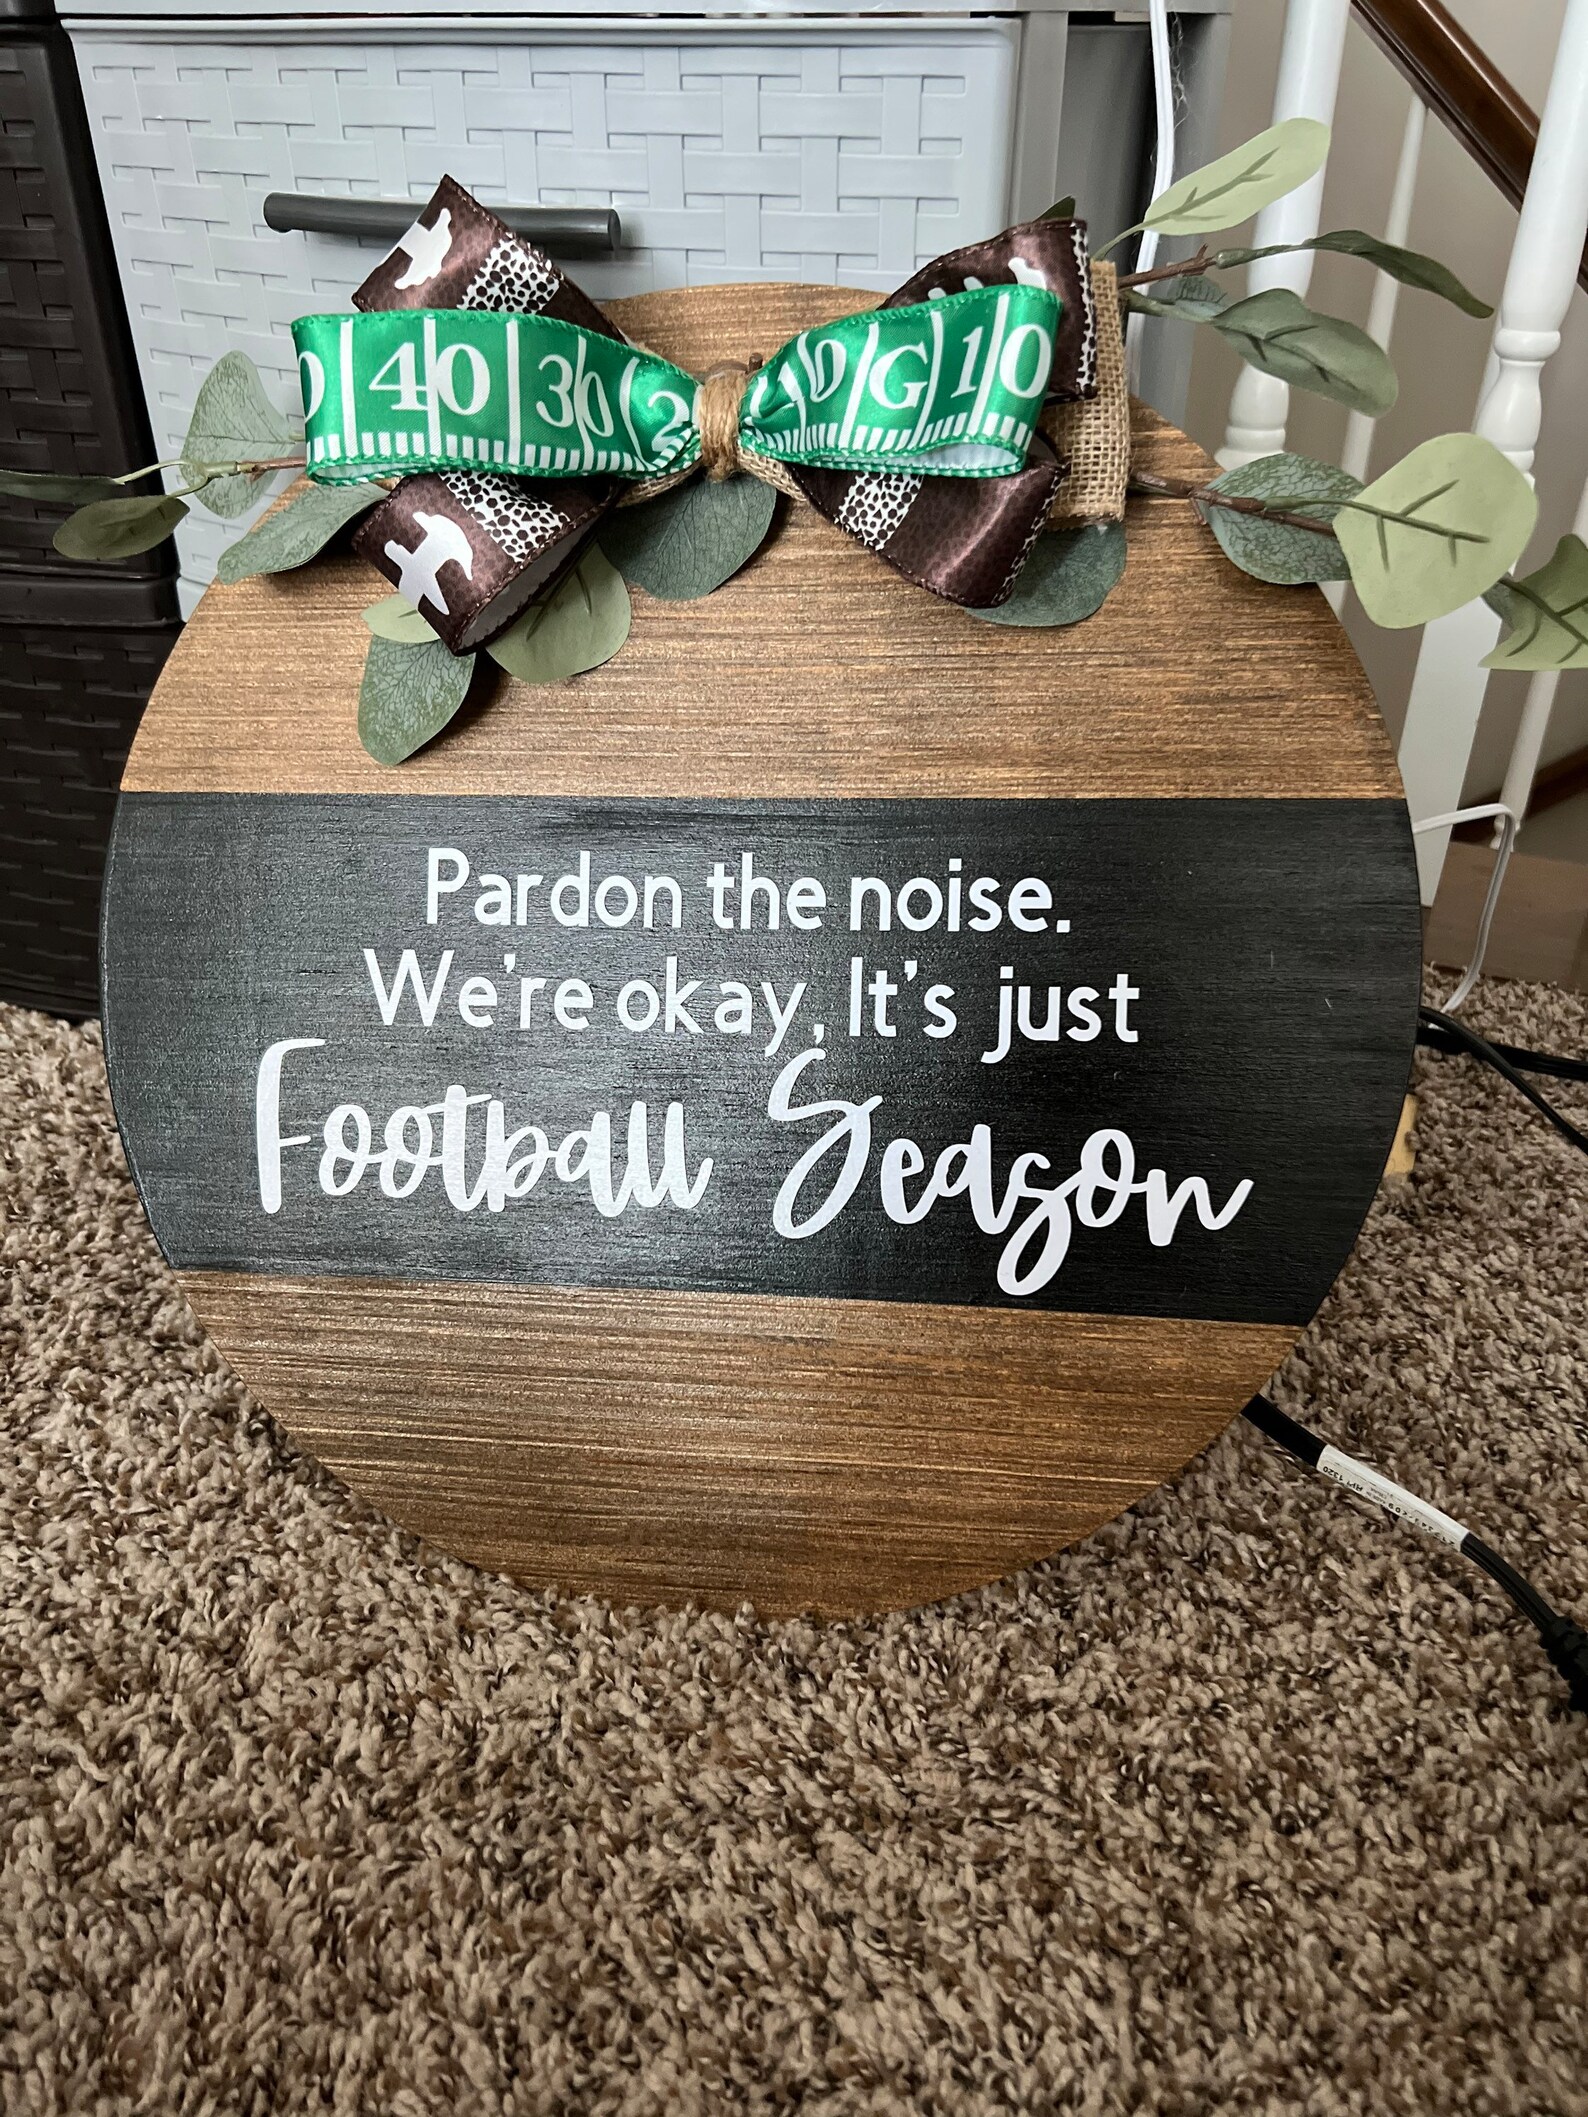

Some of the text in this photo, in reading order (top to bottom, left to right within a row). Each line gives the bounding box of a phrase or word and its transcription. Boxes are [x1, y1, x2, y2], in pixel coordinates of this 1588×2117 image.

[369, 342, 491, 416] 40
[535, 354, 614, 438] 30
[868, 341, 929, 410] G
[950, 324, 1052, 399] 10
[425, 846, 1072, 933] Pardon the noise.
[363, 947, 1140, 1064] We're okay, It's just
[254, 1036, 1254, 1297] Football Season
